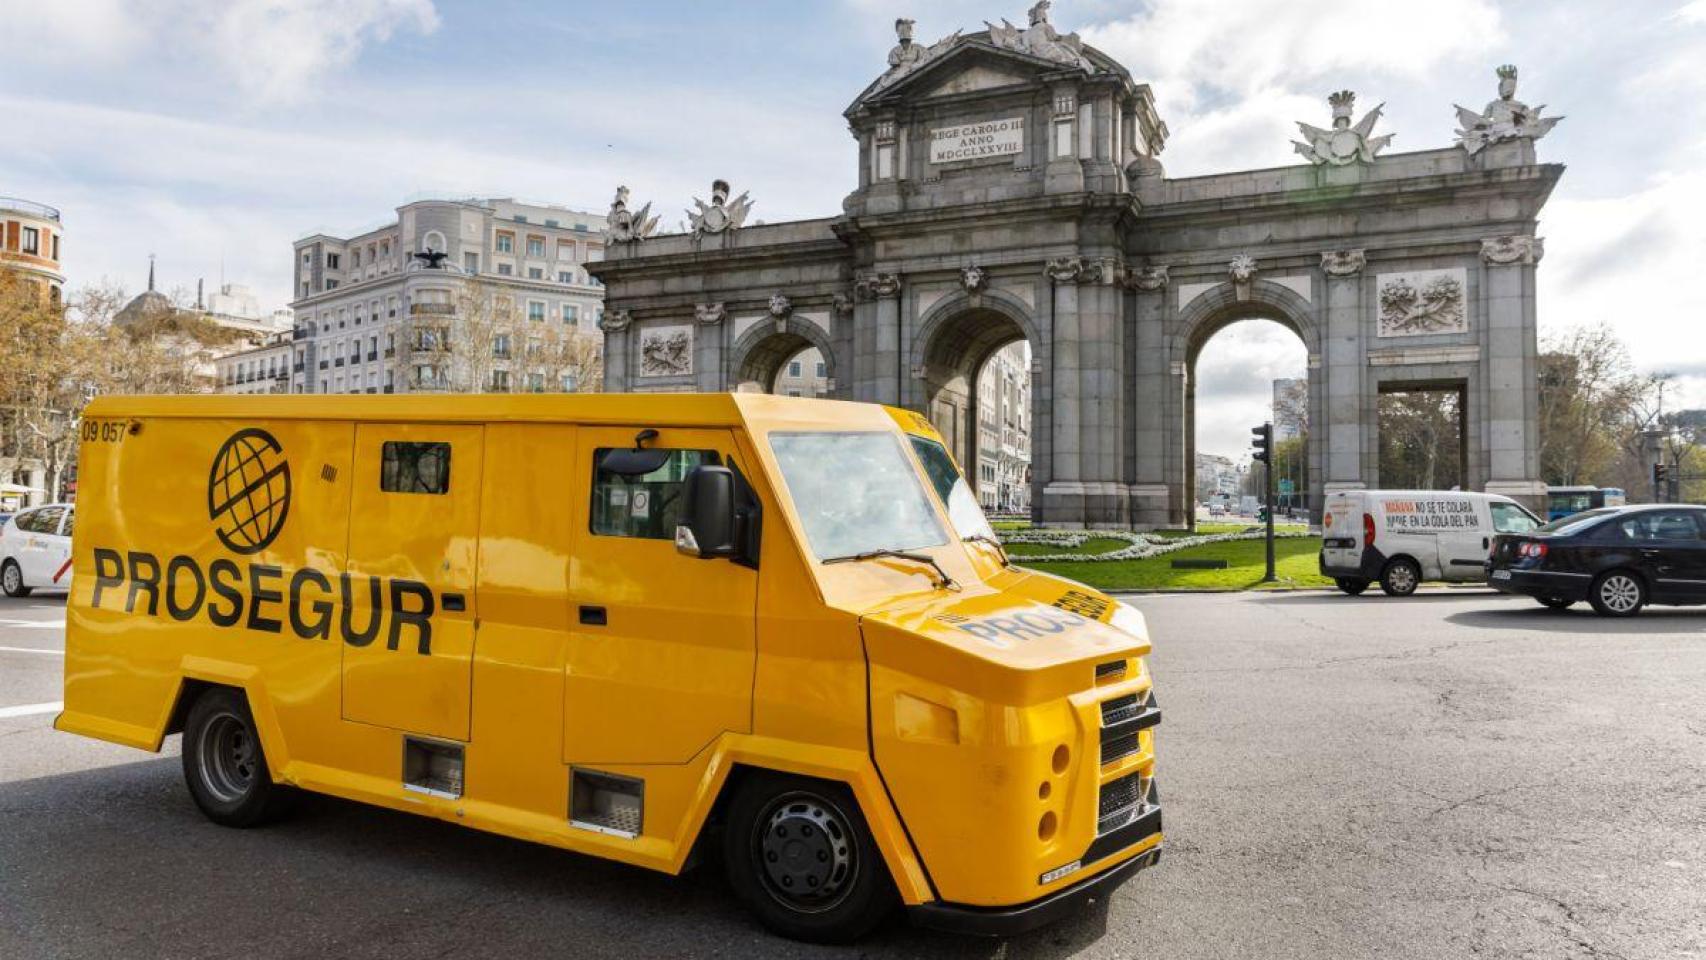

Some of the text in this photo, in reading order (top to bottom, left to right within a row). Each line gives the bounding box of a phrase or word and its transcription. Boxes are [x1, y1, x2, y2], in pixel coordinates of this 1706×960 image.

[961, 122, 1008, 136] CAROLO
[960, 134, 995, 148] ANNO
[83, 420, 126, 443] 09 057
[1416, 501, 1425, 513] NO
[1427, 501, 1436, 513] SE
[1437, 501, 1445, 513] TE
[1409, 514, 1420, 527] EN
[1421, 514, 1430, 527] LA
[1431, 514, 1448, 528] COLA
[1449, 514, 1463, 528] DEL
[1464, 514, 1479, 528] PAN
[91, 547, 435, 656] PROSEGUR
